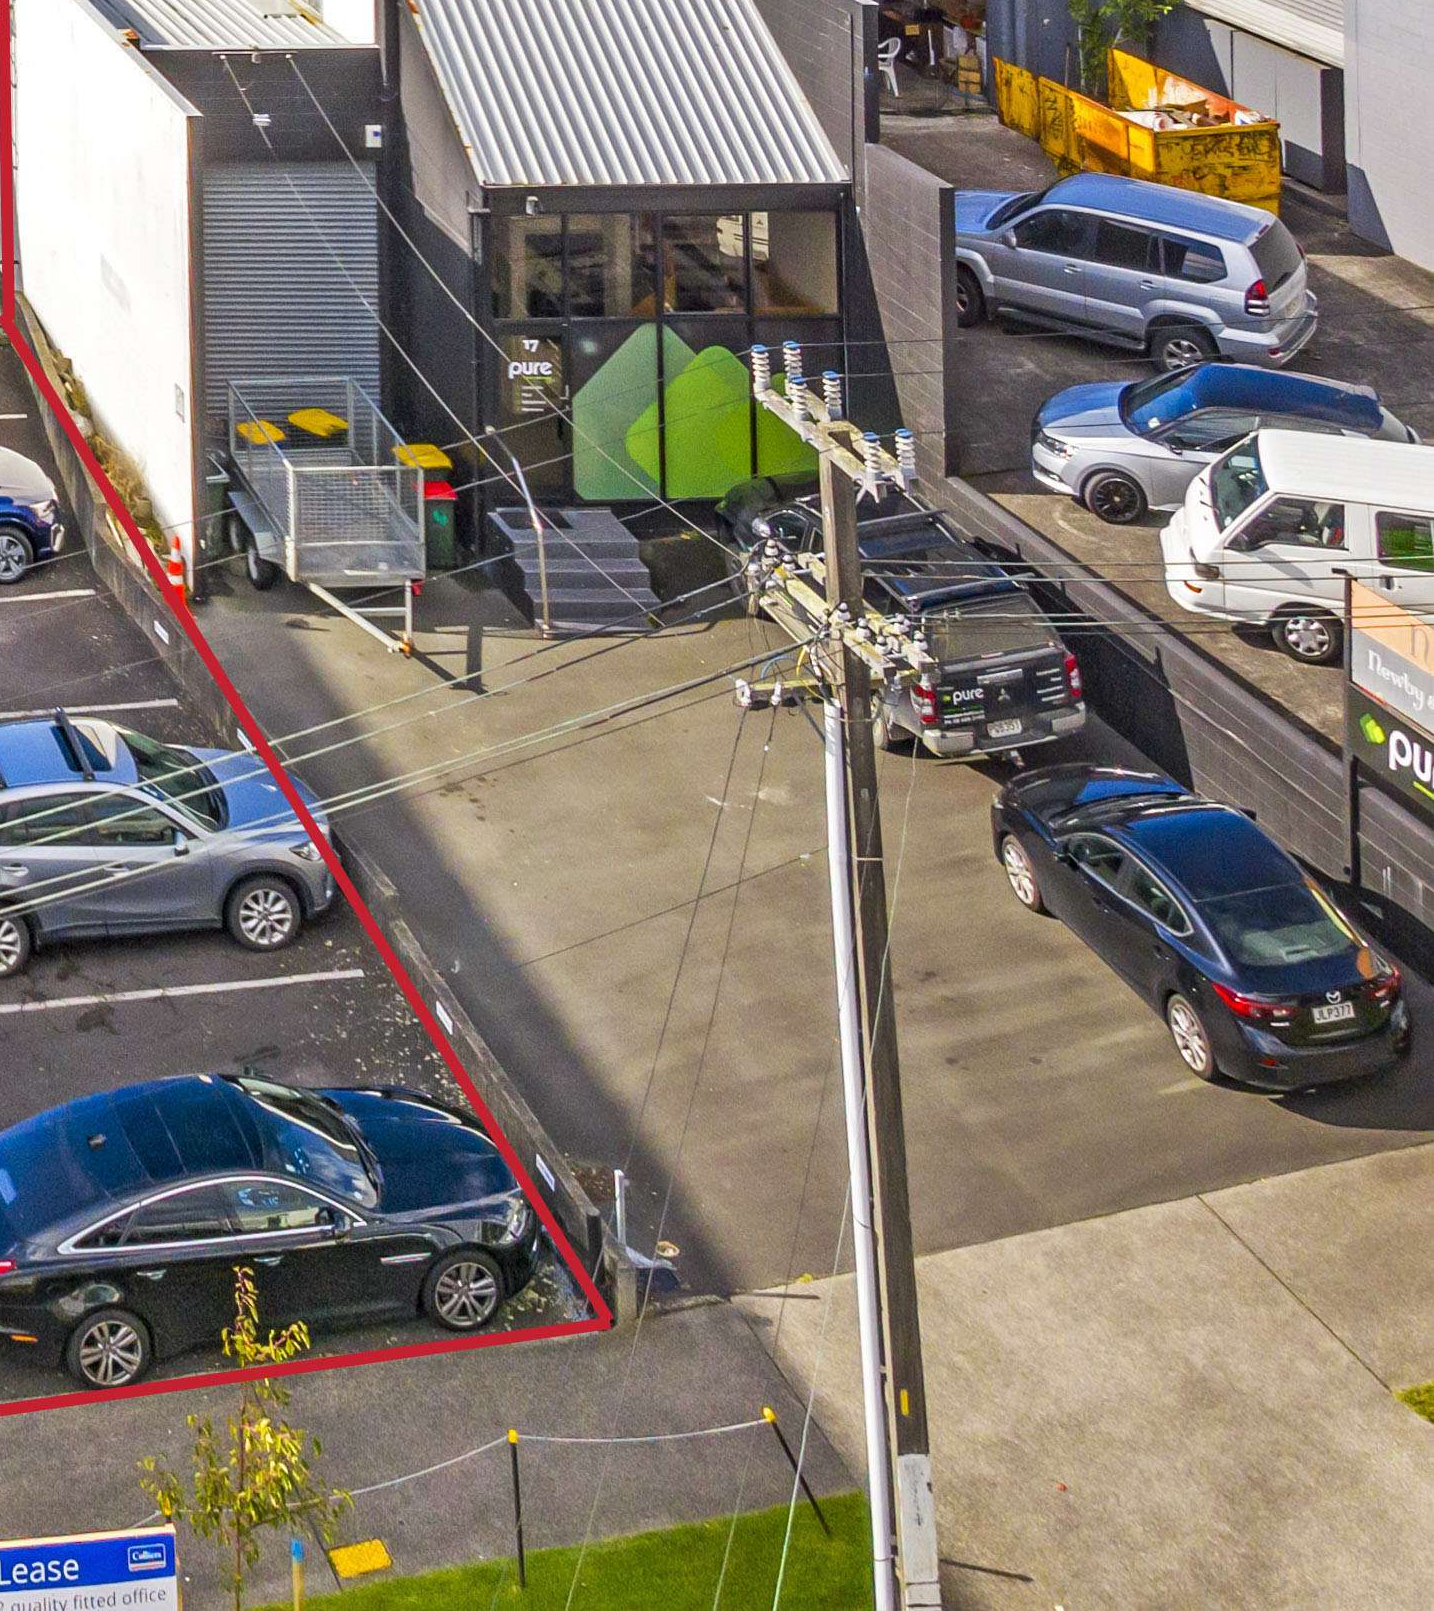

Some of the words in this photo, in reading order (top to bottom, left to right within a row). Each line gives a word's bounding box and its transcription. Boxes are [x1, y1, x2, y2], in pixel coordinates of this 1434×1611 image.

[522, 339, 540, 353] 17
[508, 361, 553, 380] pure
[952, 687, 985, 706] pure
[1315, 1001, 1353, 1021] JLP377
[10, 1595, 68, 1611] quality
[73, 1591, 117, 1608] fitted
[121, 1588, 166, 1605] office
